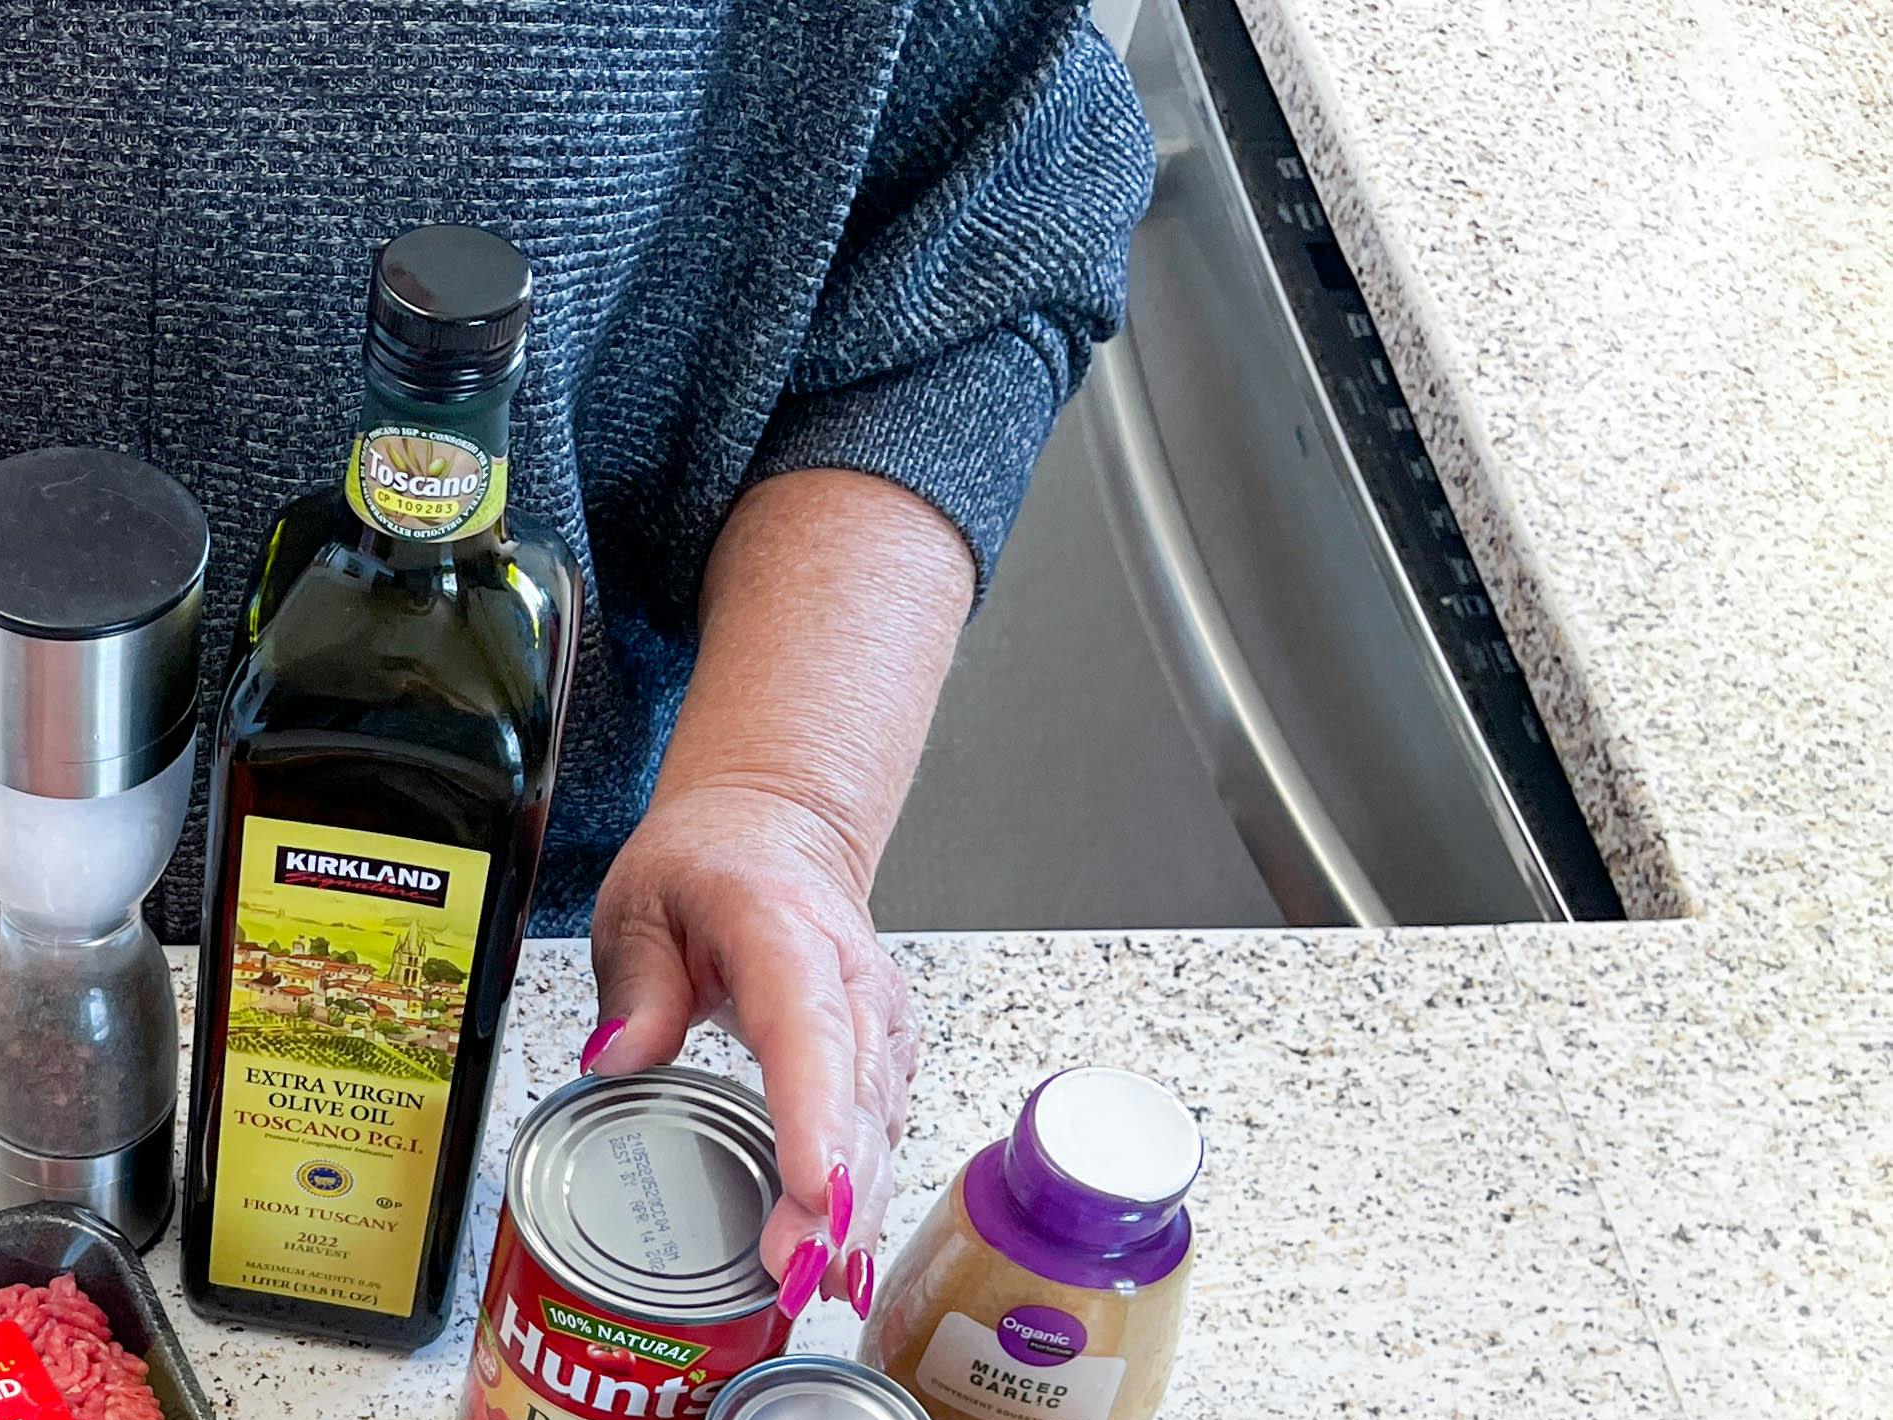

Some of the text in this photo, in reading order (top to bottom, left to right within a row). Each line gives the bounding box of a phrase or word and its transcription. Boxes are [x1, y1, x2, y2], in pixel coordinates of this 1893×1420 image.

[369, 448, 479, 498] Toscano
[377, 491, 453, 515] CP 109283
[286, 852, 442, 891] KIRKLAND
[246, 1067, 426, 1110] EXTRA VIRGIN
[269, 1093, 394, 1126] OLIVE OIL
[234, 1110, 424, 1154] TOSCANO P.G.I.
[242, 1198, 399, 1233] FROM TUSCANY
[283, 1241, 352, 1259] HARVEST
[298, 1231, 338, 1248] 2022
[548, 1306, 692, 1363] 100% NATURAL
[1002, 1316, 1071, 1346] Organic
[969, 1373, 1061, 1409] GARLIC
[971, 1359, 1069, 1397] MINCED
